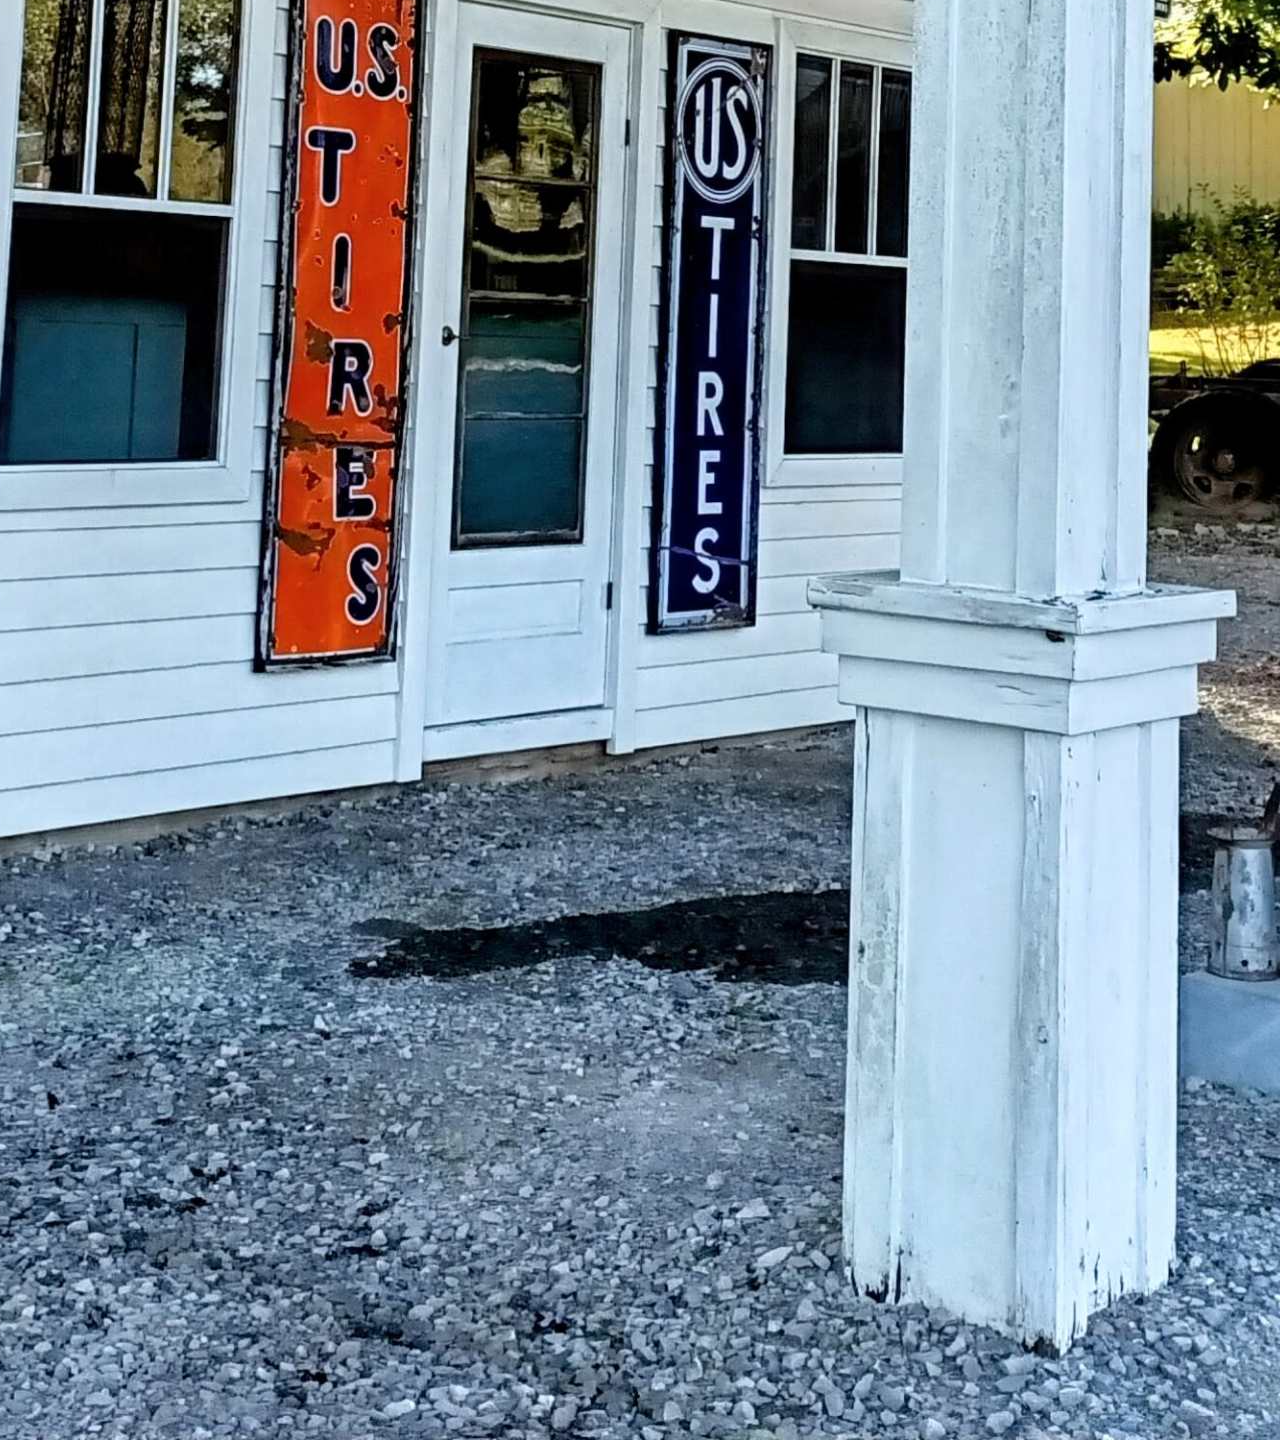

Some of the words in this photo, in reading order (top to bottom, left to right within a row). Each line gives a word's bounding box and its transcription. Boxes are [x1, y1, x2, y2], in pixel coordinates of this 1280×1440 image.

[693, 76, 749, 181] US
[305, 125, 381, 625] TIRES
[691, 215, 735, 595] TIRES
